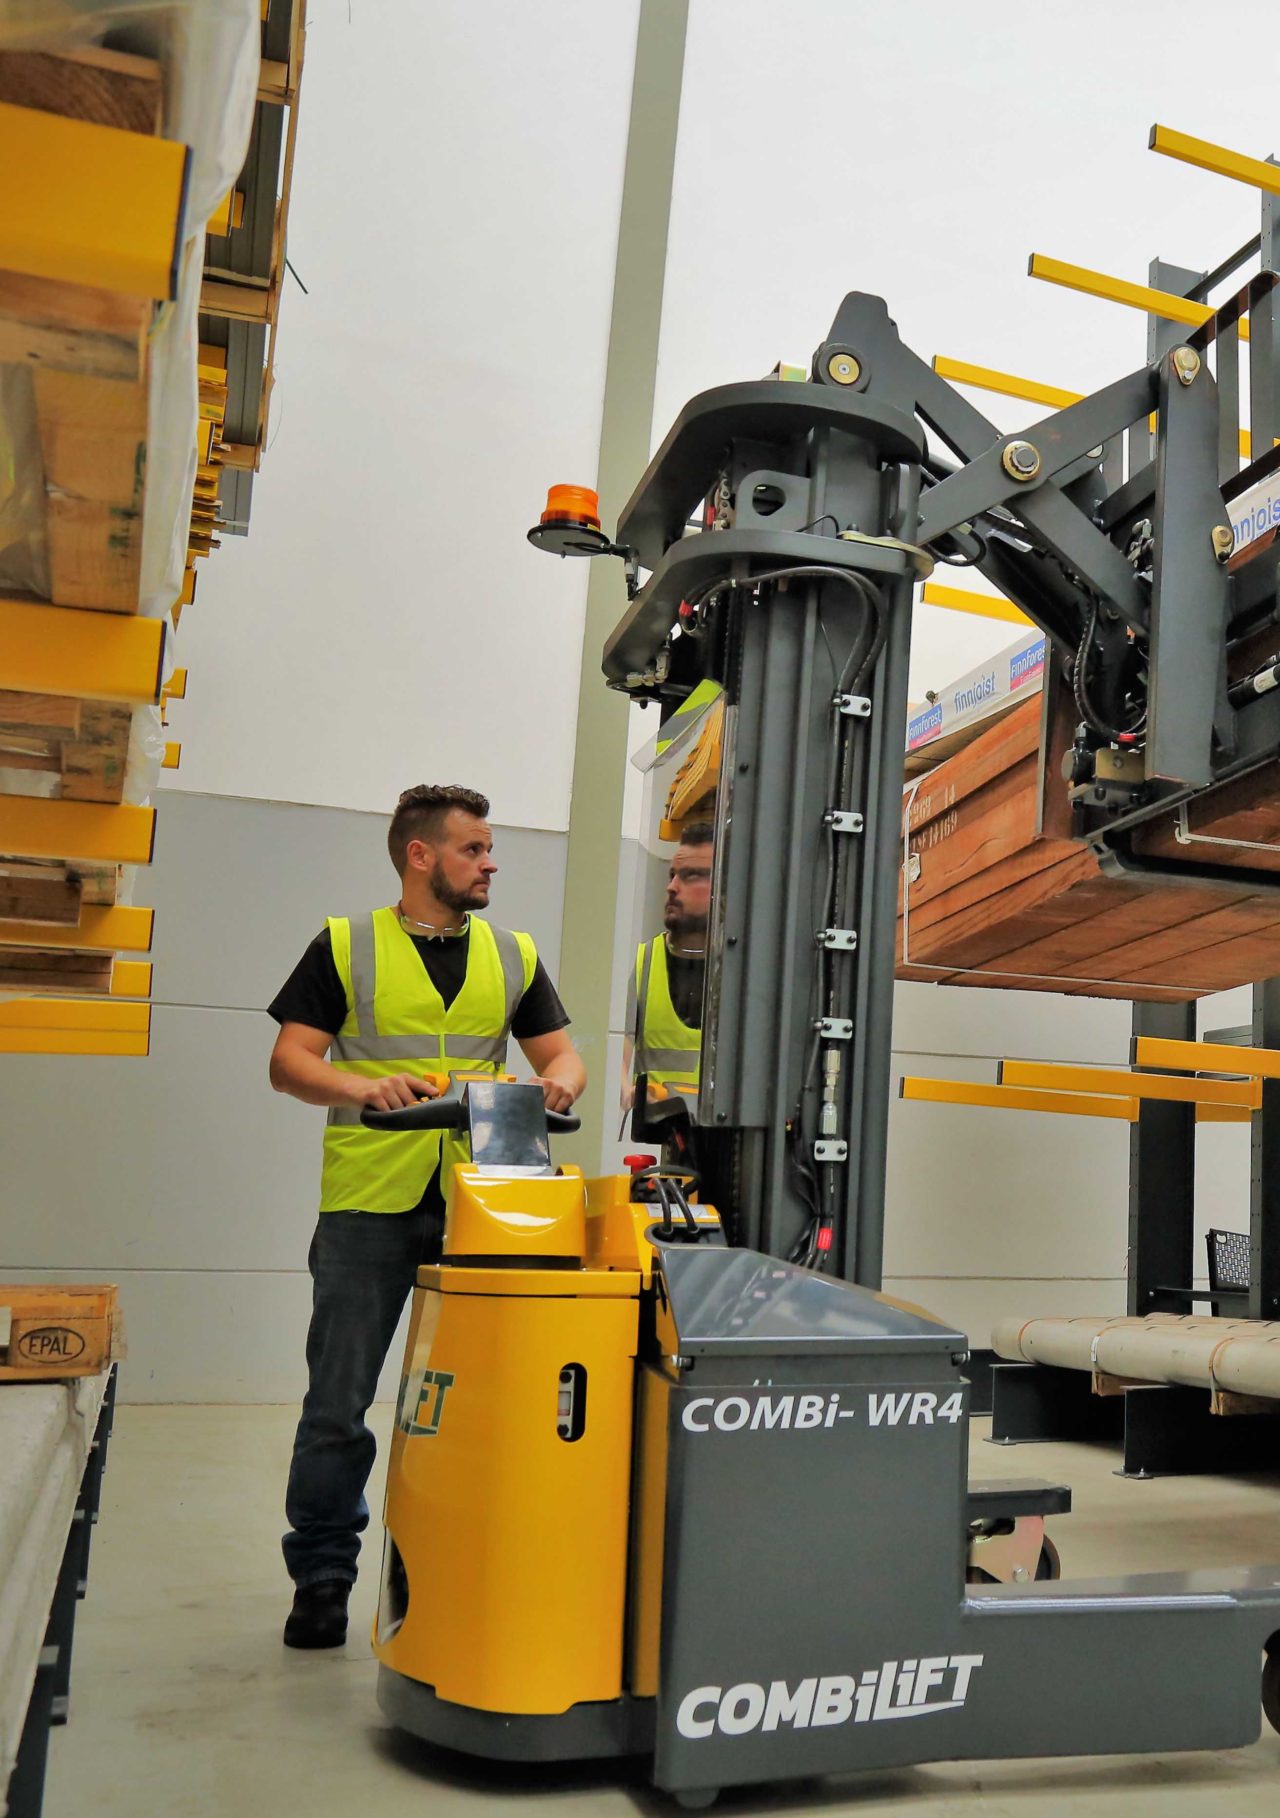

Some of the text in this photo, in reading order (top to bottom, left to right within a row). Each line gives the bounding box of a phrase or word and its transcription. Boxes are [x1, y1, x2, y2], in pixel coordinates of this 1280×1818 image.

[954, 671, 996, 714] finnjoist
[28, 1335, 73, 1355] EPAL
[867, 1392, 963, 1427] WR4
